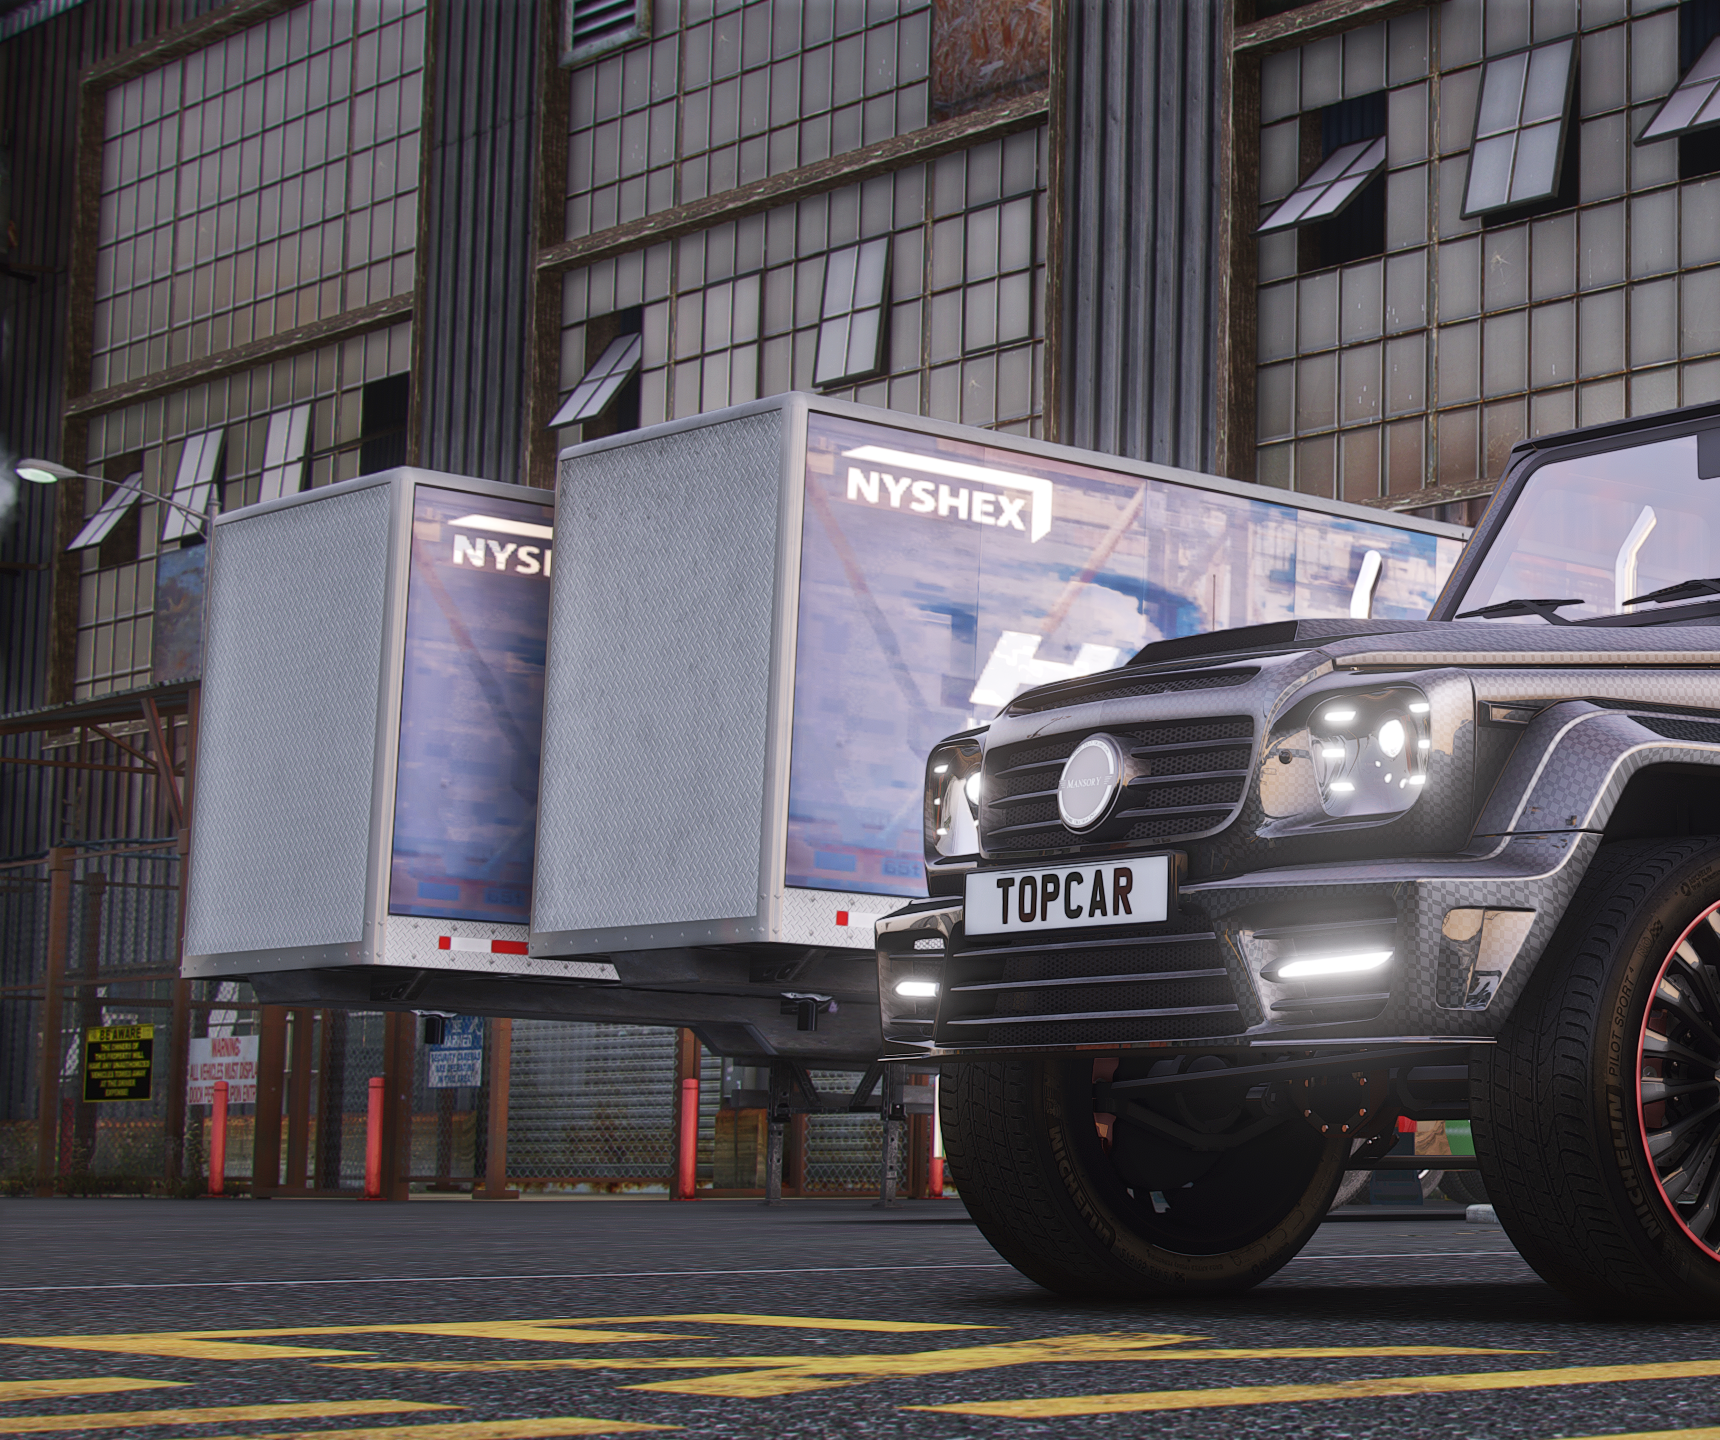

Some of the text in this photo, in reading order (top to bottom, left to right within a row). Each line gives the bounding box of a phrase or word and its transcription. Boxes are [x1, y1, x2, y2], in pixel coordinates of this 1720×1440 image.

[847, 467, 1026, 533] NYSHEX
[1066, 776, 1102, 789] MANSORY
[996, 866, 1133, 925] TOPCAR
[100, 1027, 142, 1041] BE AWARE
[1608, 966, 1635, 1077] PILOT SPORT 4
[189, 1063, 200, 1082] ALL
[201, 1062, 223, 1081] VEHICLES
[224, 1061, 240, 1080] MUST
[1608, 1093, 1662, 1241] MICHELIN
